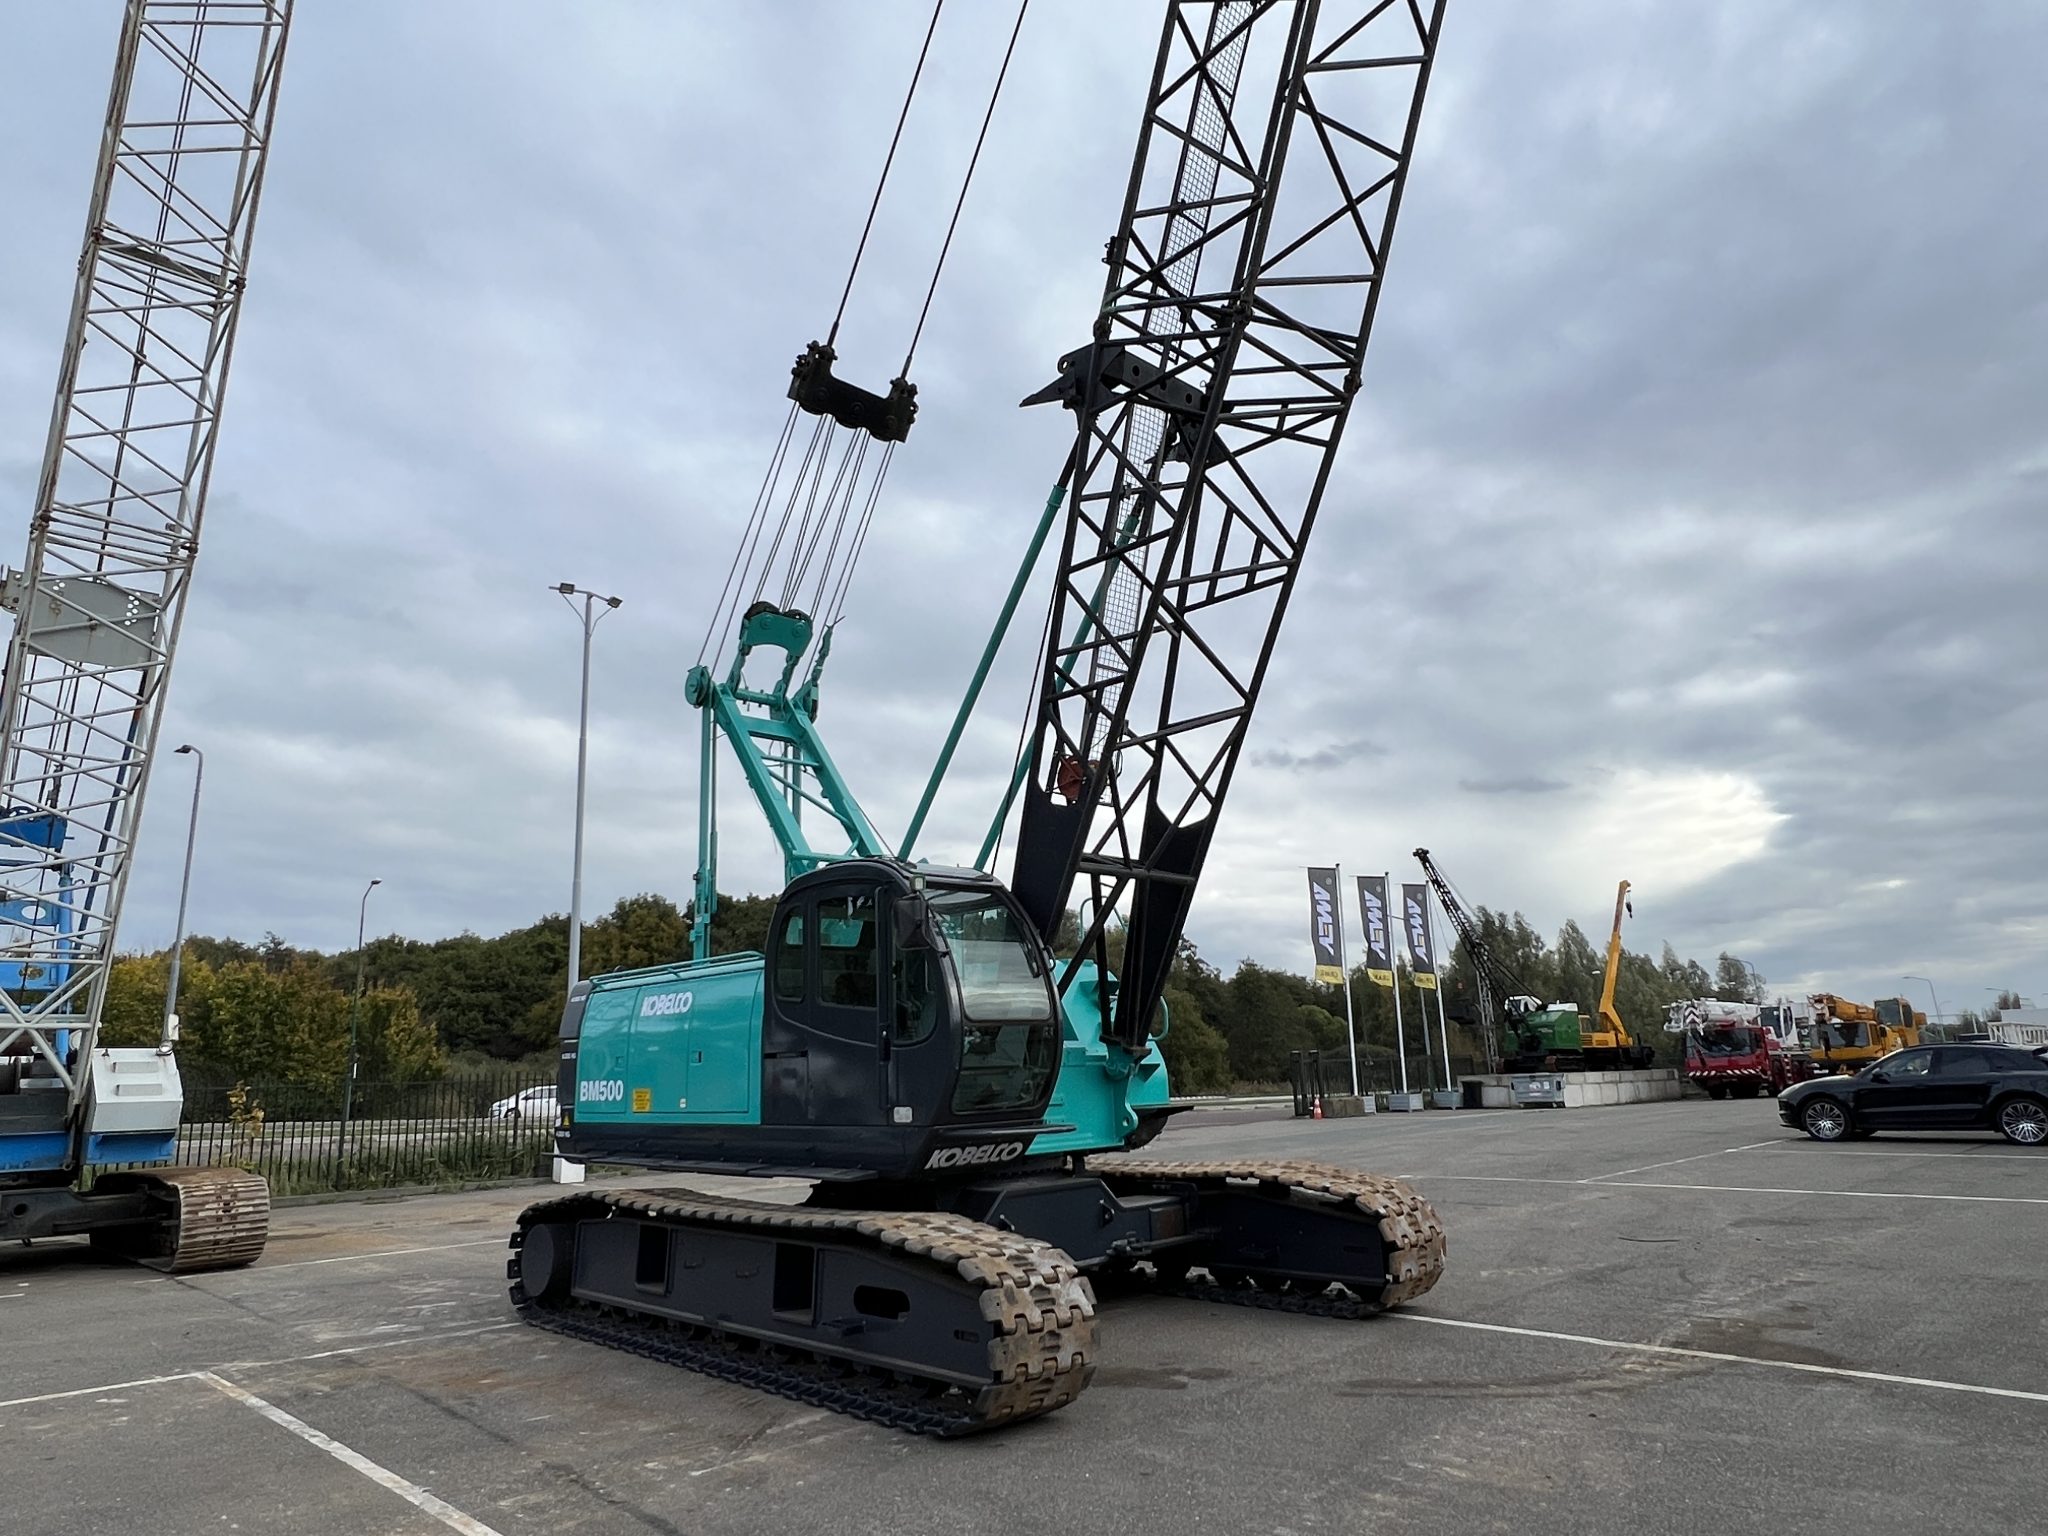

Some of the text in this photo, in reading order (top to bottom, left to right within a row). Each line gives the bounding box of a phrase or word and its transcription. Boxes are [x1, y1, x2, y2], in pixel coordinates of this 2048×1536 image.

[640, 991, 693, 1017] KOBELCO
[580, 1079, 624, 1102] BM500
[923, 1142, 1024, 1170] KOBELCO
